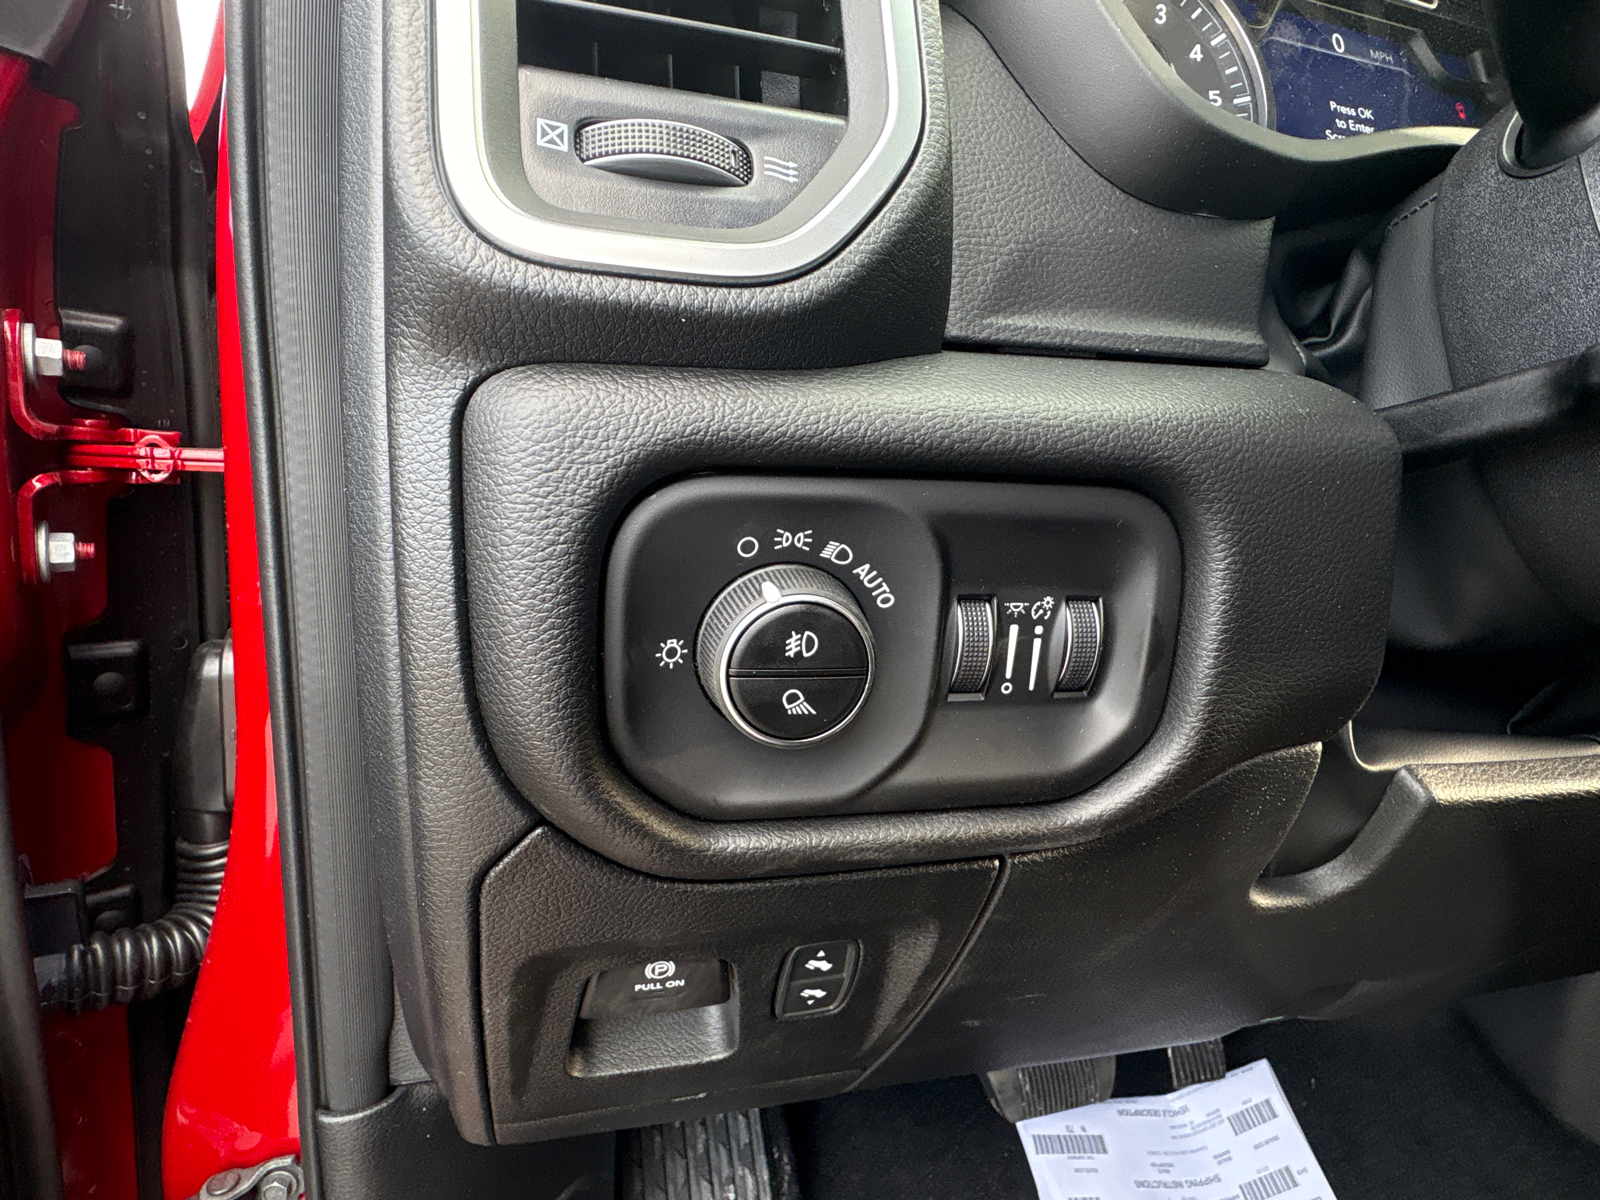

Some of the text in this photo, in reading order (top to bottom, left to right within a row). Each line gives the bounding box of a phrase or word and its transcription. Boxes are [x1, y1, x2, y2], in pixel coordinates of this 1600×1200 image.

[1154, 3, 1167, 25] 3
[1189, 43, 1203, 62] 4
[1331, 32, 1394, 64] 0 MPH
[1208, 89, 1222, 107] 5
[1329, 100, 1375, 120] Press OK
[1335, 118, 1375, 134] to Enter
[852, 563, 895, 609] AUTO
[634, 979, 685, 992] PULL ON
[1133, 1173, 1222, 1189] SHIPPING INSTRUCTIONS
